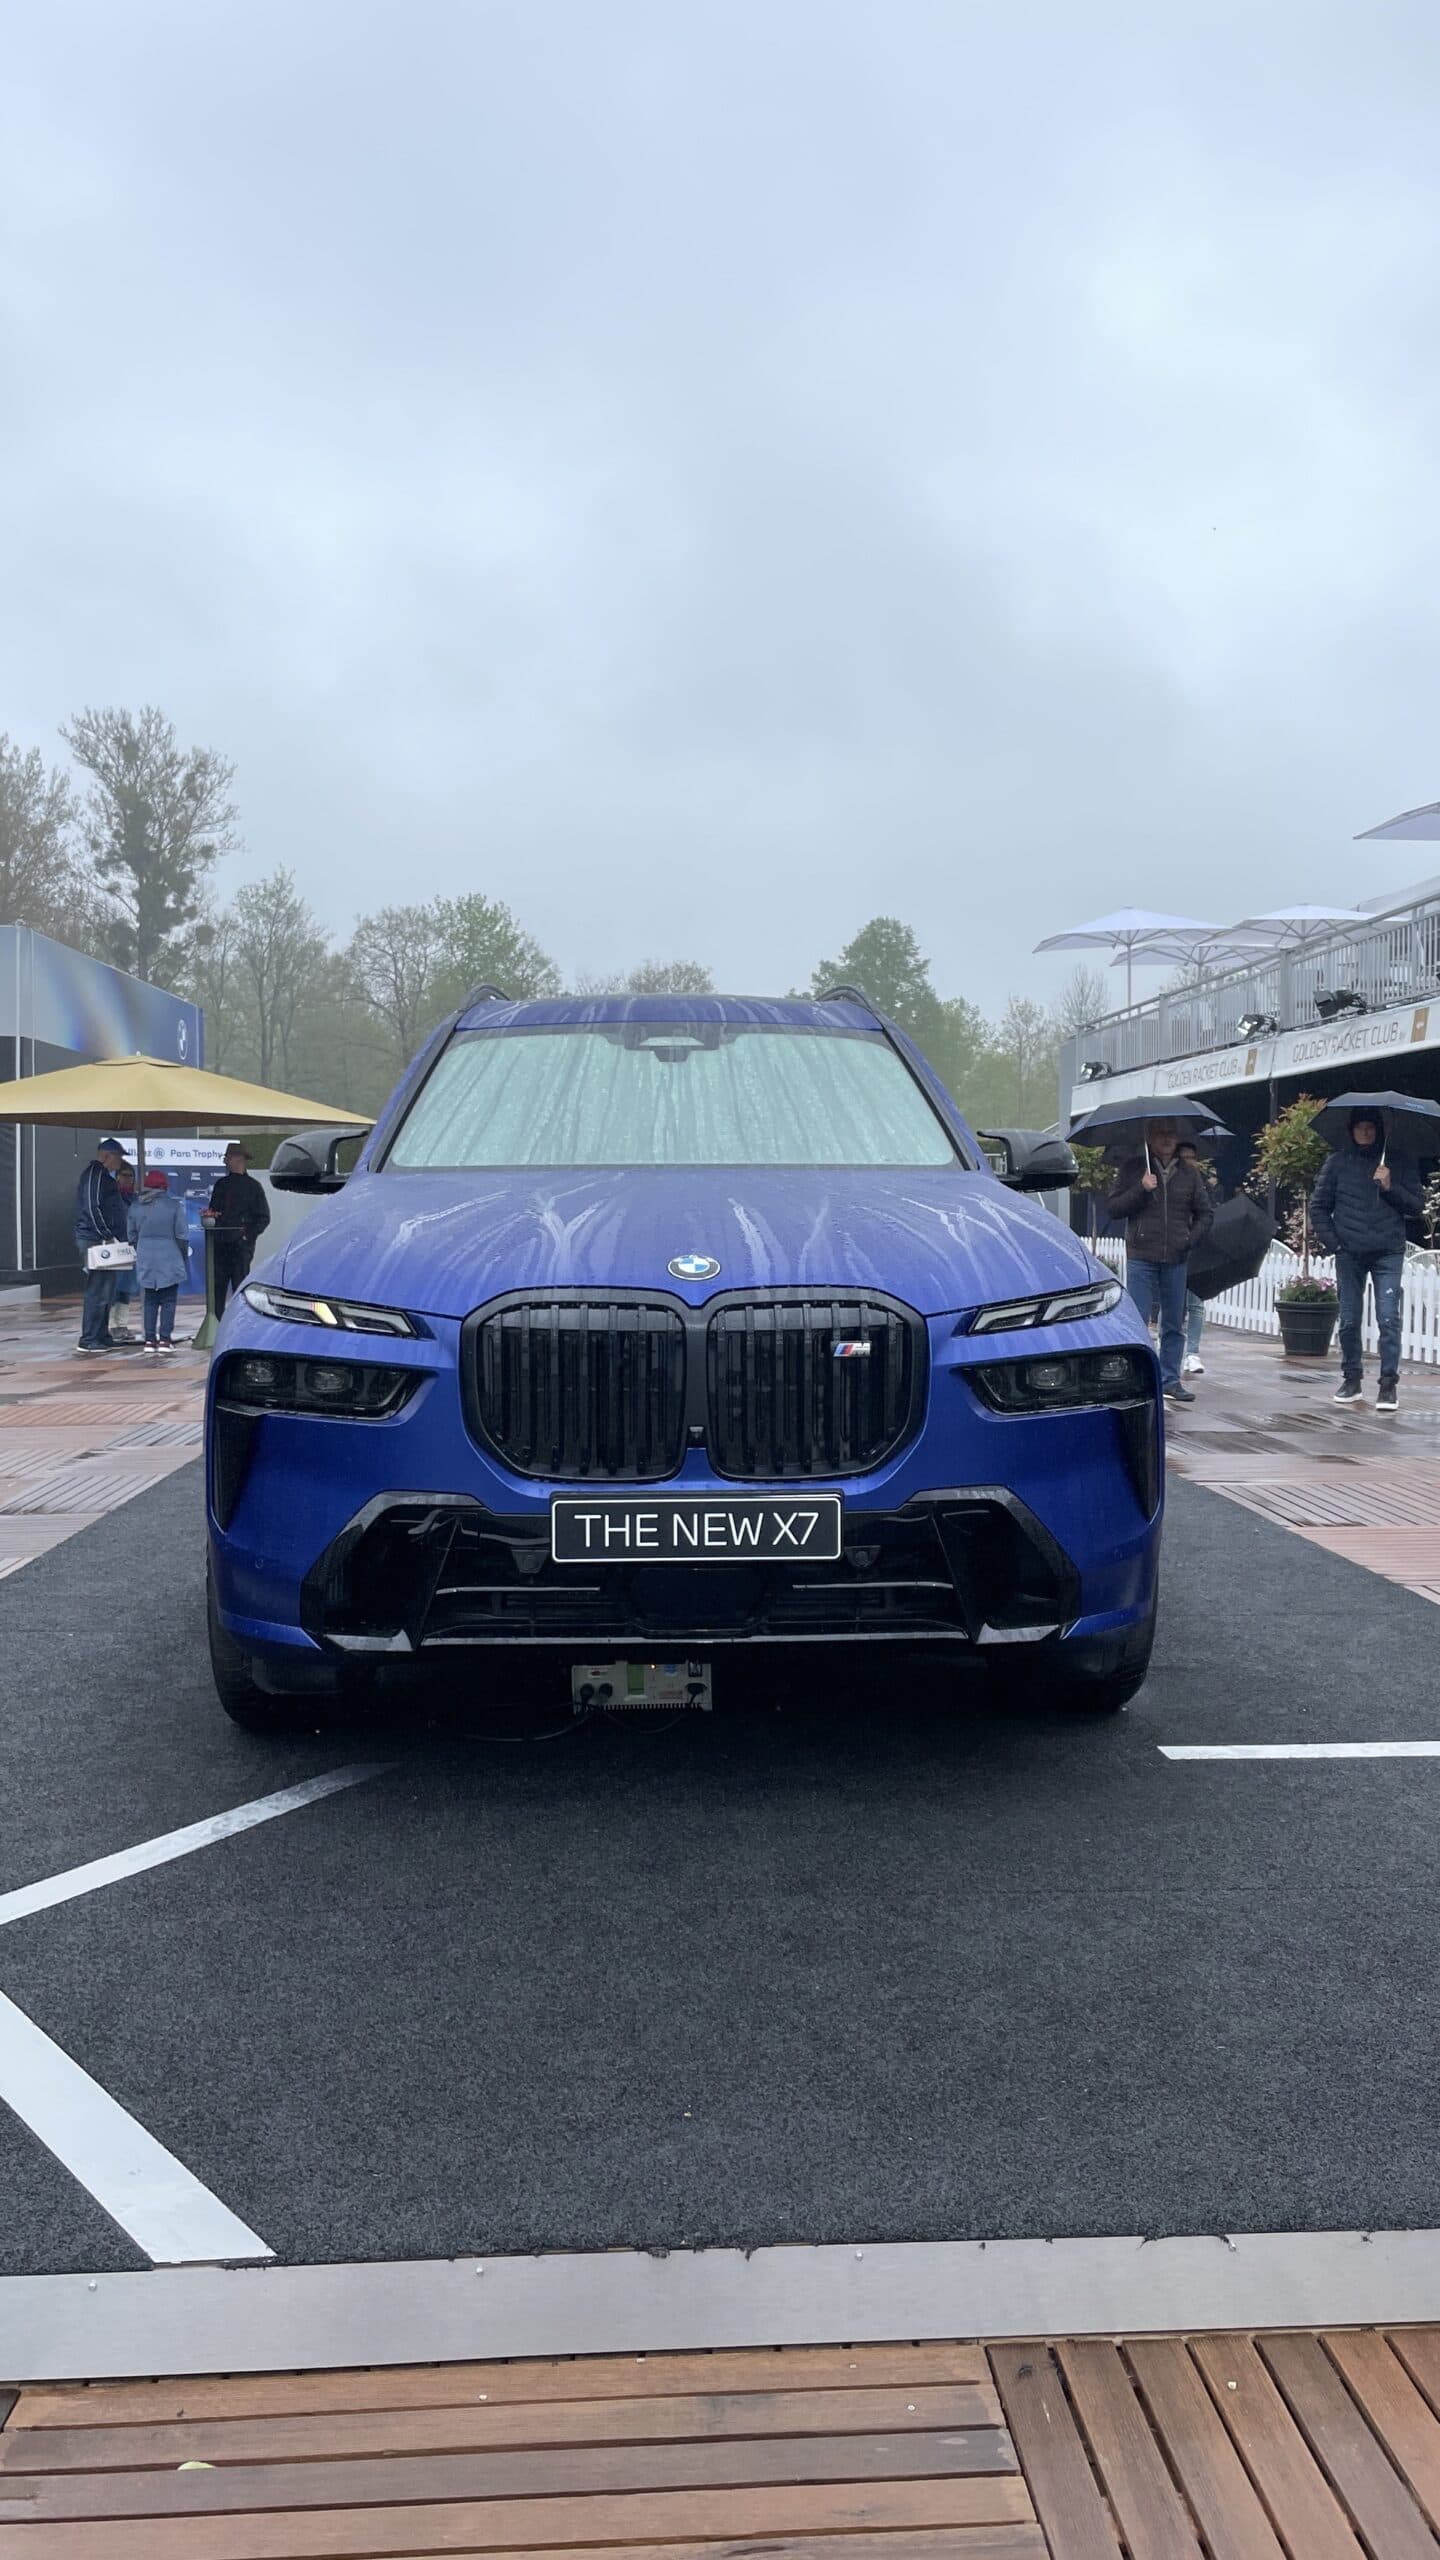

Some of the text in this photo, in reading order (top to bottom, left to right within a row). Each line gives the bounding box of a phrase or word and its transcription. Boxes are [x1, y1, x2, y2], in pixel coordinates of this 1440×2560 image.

[1292, 1038, 1330, 1063] GOLDEN
[1331, 1028, 1370, 1054] RACKET
[1371, 1021, 1400, 1046] CLUB
[574, 1511, 820, 1548] THE NEW X7
